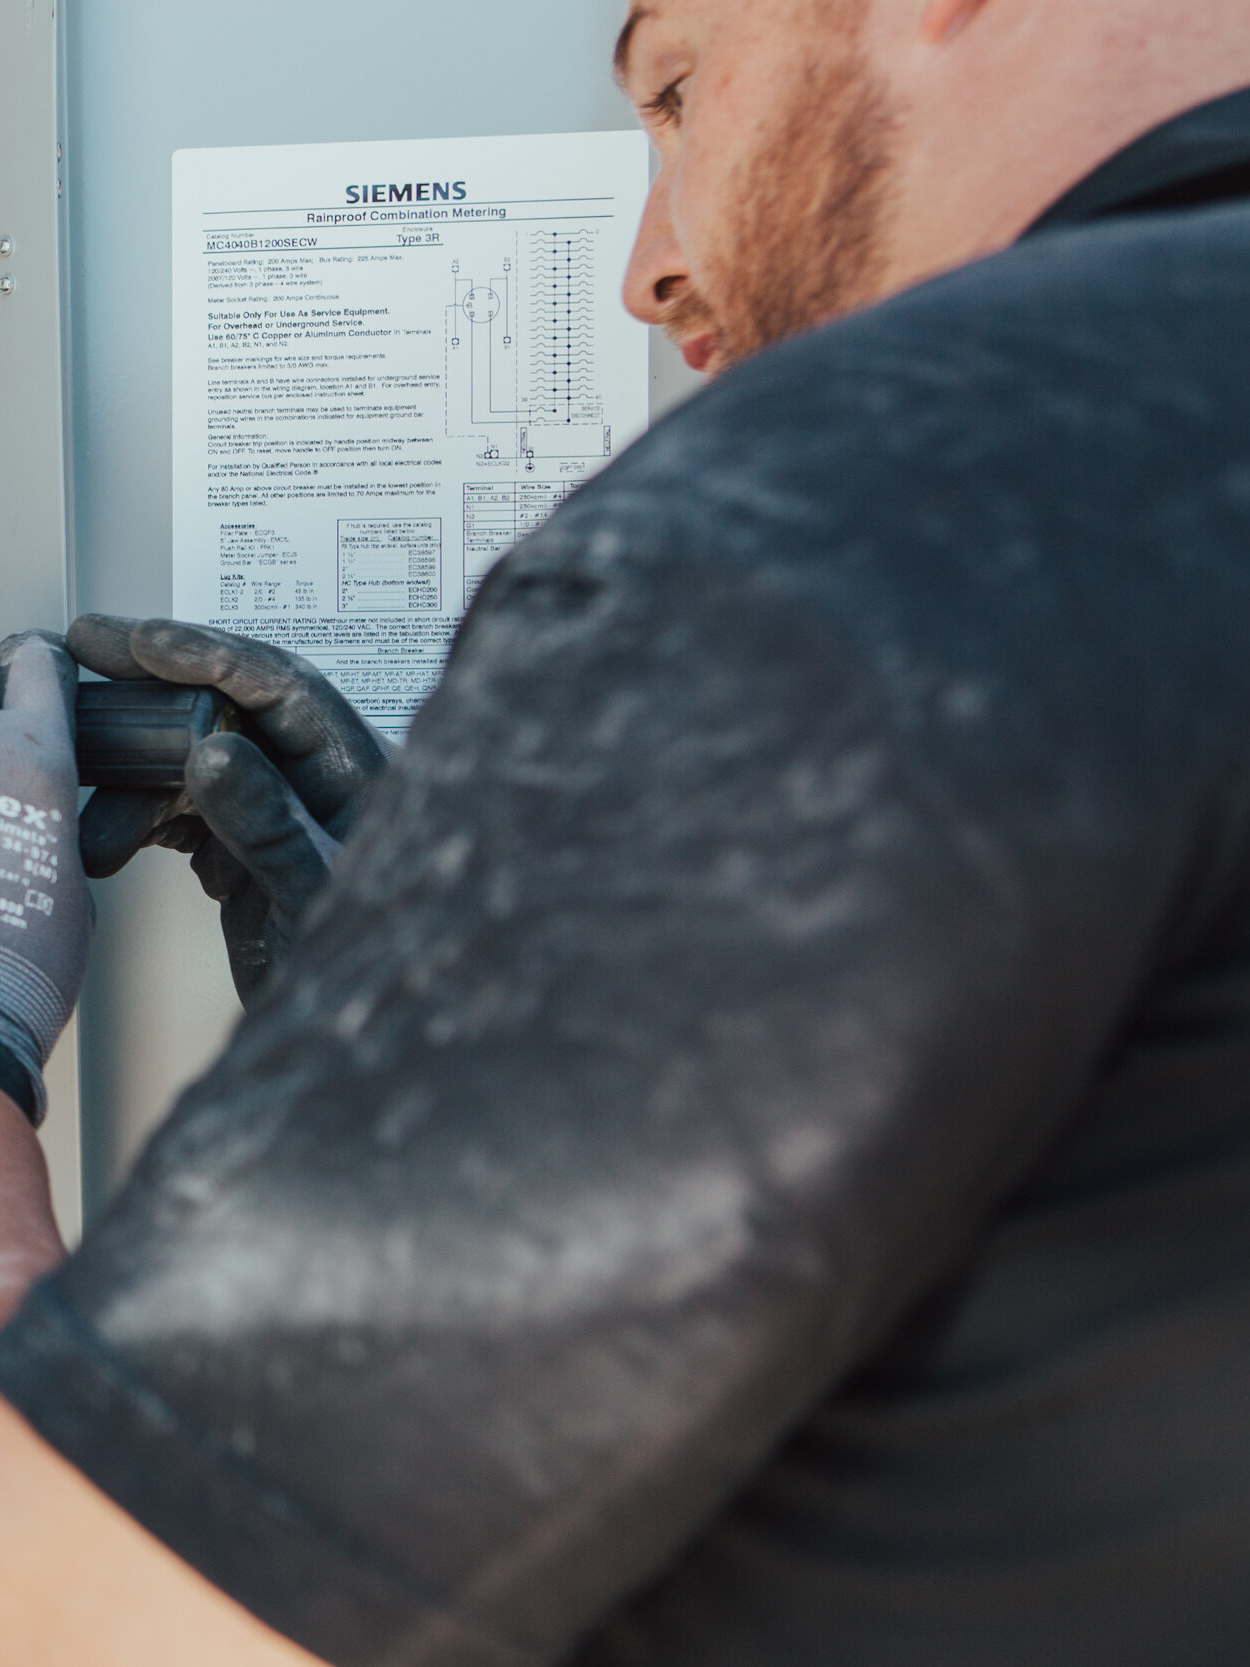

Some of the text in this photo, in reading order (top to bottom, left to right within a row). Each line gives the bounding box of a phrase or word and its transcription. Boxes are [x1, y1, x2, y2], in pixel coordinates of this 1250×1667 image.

[345, 181, 467, 204] SIEMENS
[307, 206, 506, 225] Rainproof Combination Metering
[207, 237, 318, 250] MC4040B1200SECW
[397, 233, 440, 246] Type 3R
[242, 311, 261, 320] Only
[343, 307, 389, 317] Equipment.
[276, 320, 329, 329] Underground
[261, 332, 292, 340] Copper
